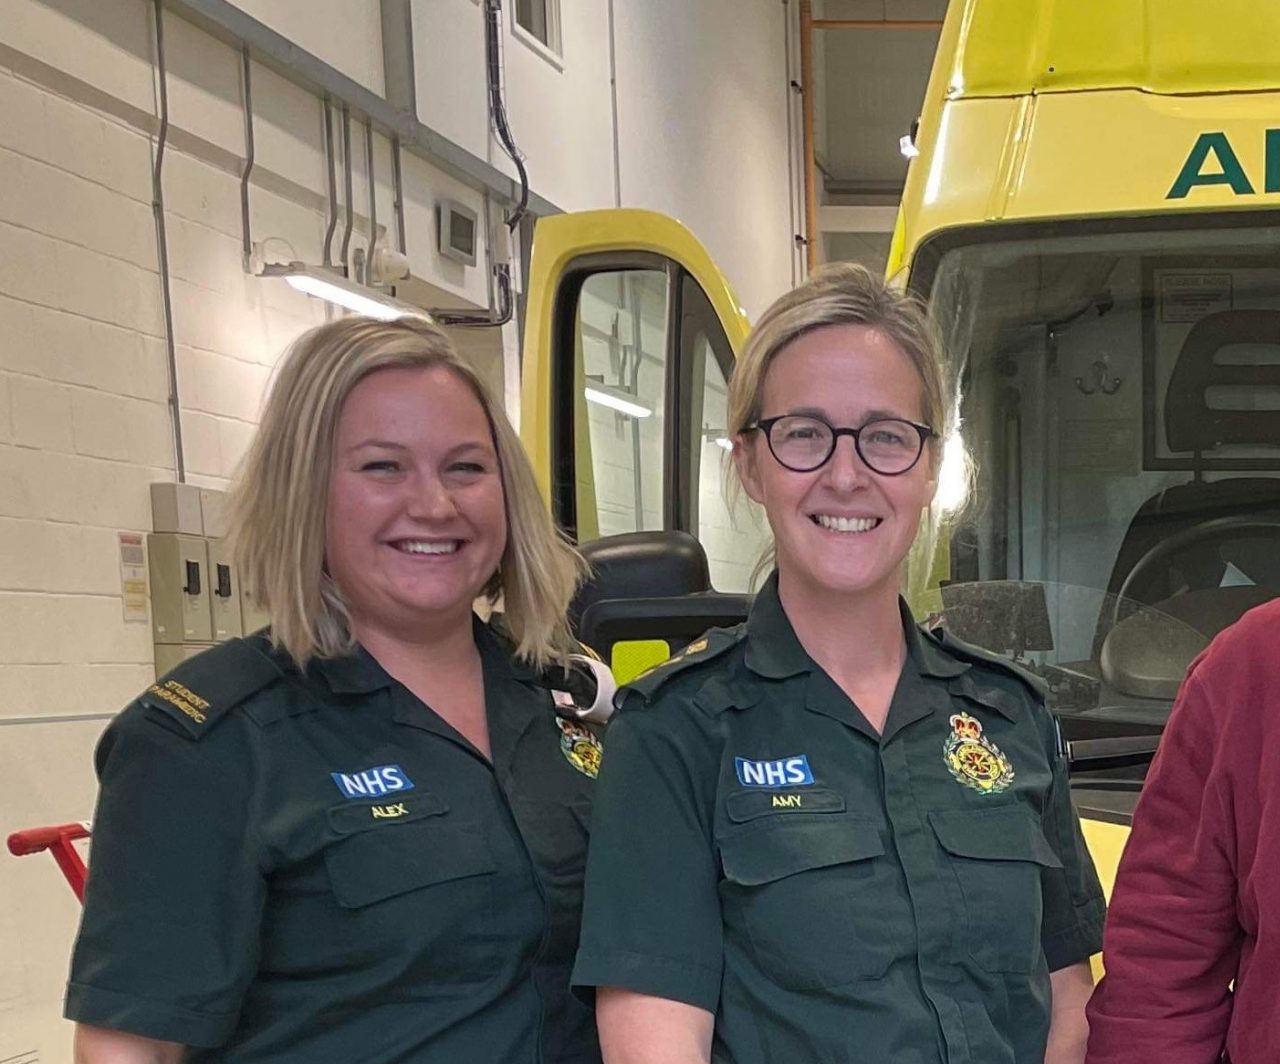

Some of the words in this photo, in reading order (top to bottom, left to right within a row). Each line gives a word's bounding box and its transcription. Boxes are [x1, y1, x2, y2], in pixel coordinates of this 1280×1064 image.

[342, 767, 403, 795] NHS
[743, 759, 806, 785] NHS
[371, 802, 409, 819] ALEX
[772, 795, 802, 808] AMY
